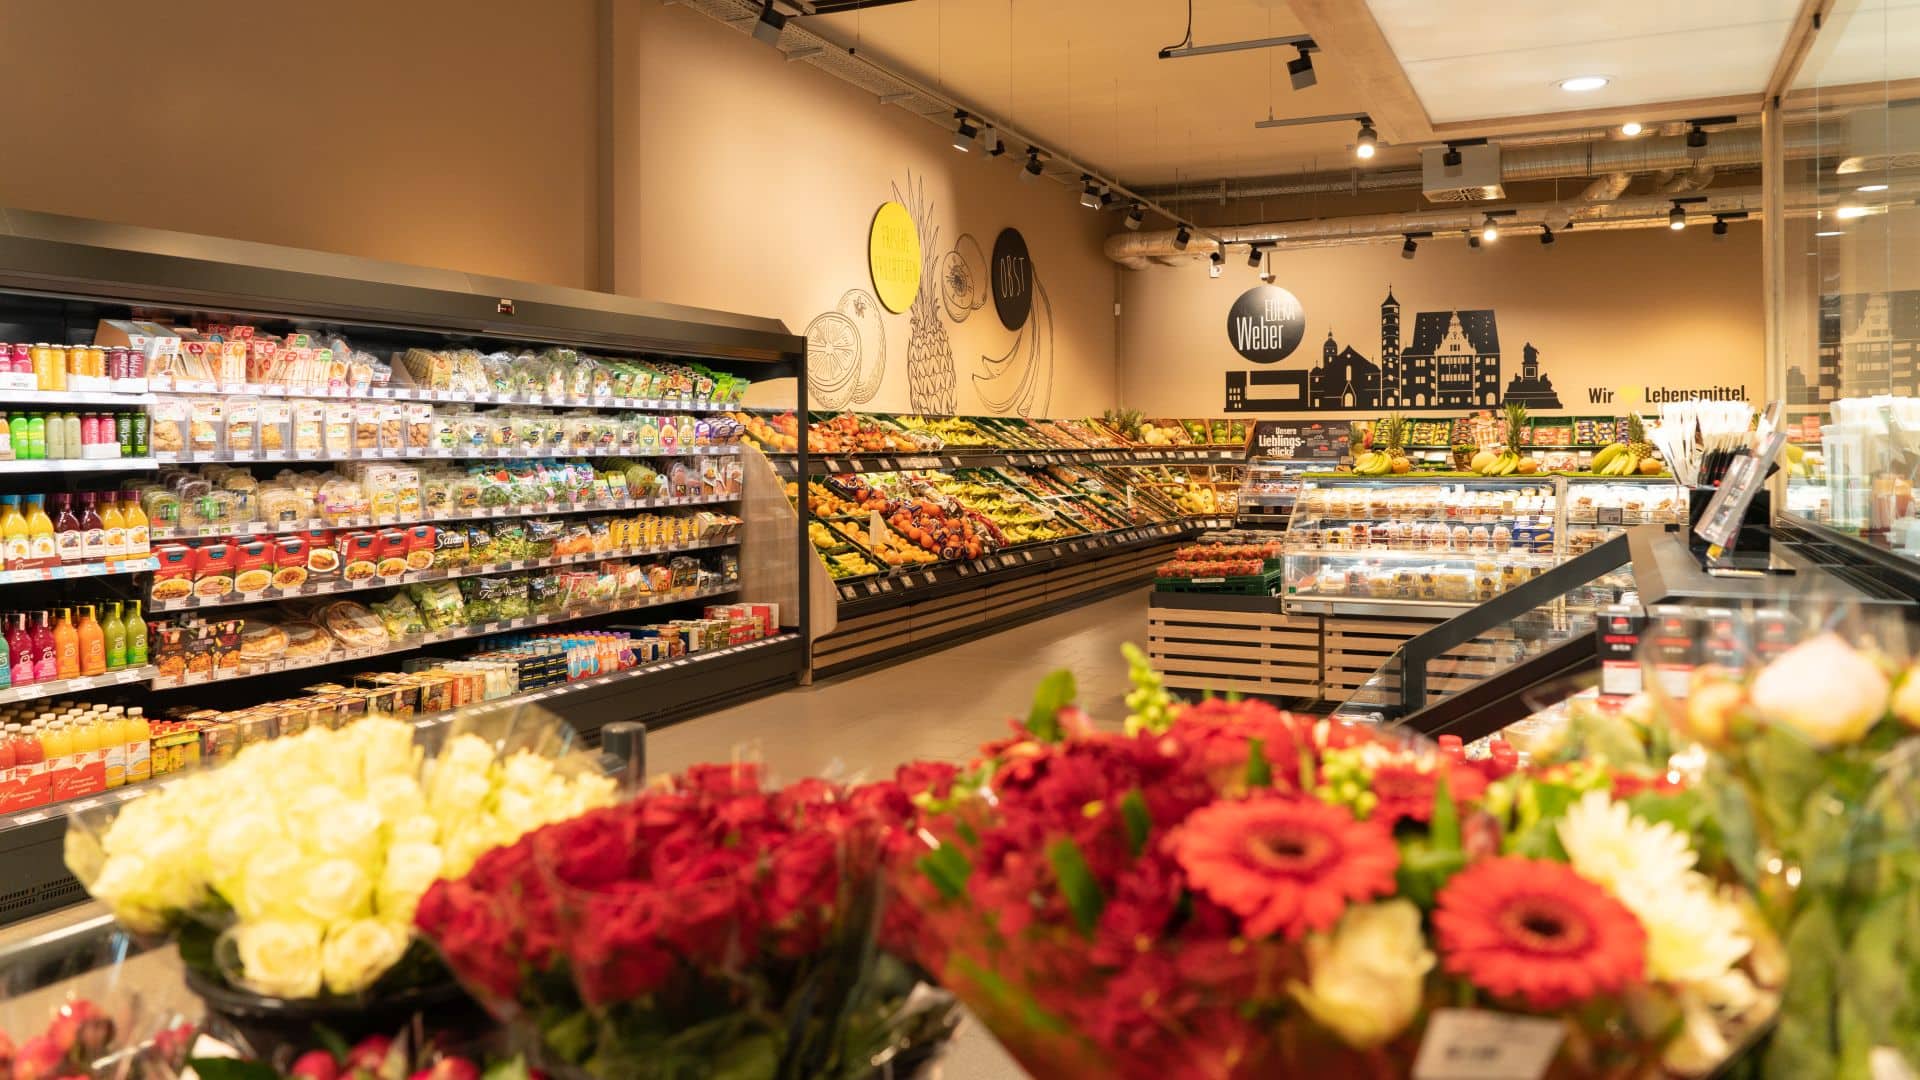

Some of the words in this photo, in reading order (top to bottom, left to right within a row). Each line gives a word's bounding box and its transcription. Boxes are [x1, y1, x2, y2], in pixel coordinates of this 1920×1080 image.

[1000, 255, 1025, 298] OBST
[1236, 315, 1284, 351] Weber
[1588, 387, 1615, 404] Wir
[1645, 384, 1751, 403] Lebensmittel.
[1275, 426, 1297, 435] Unsere
[1258, 434, 1306, 449] Lieblings-
[1266, 447, 1294, 457] stücke
